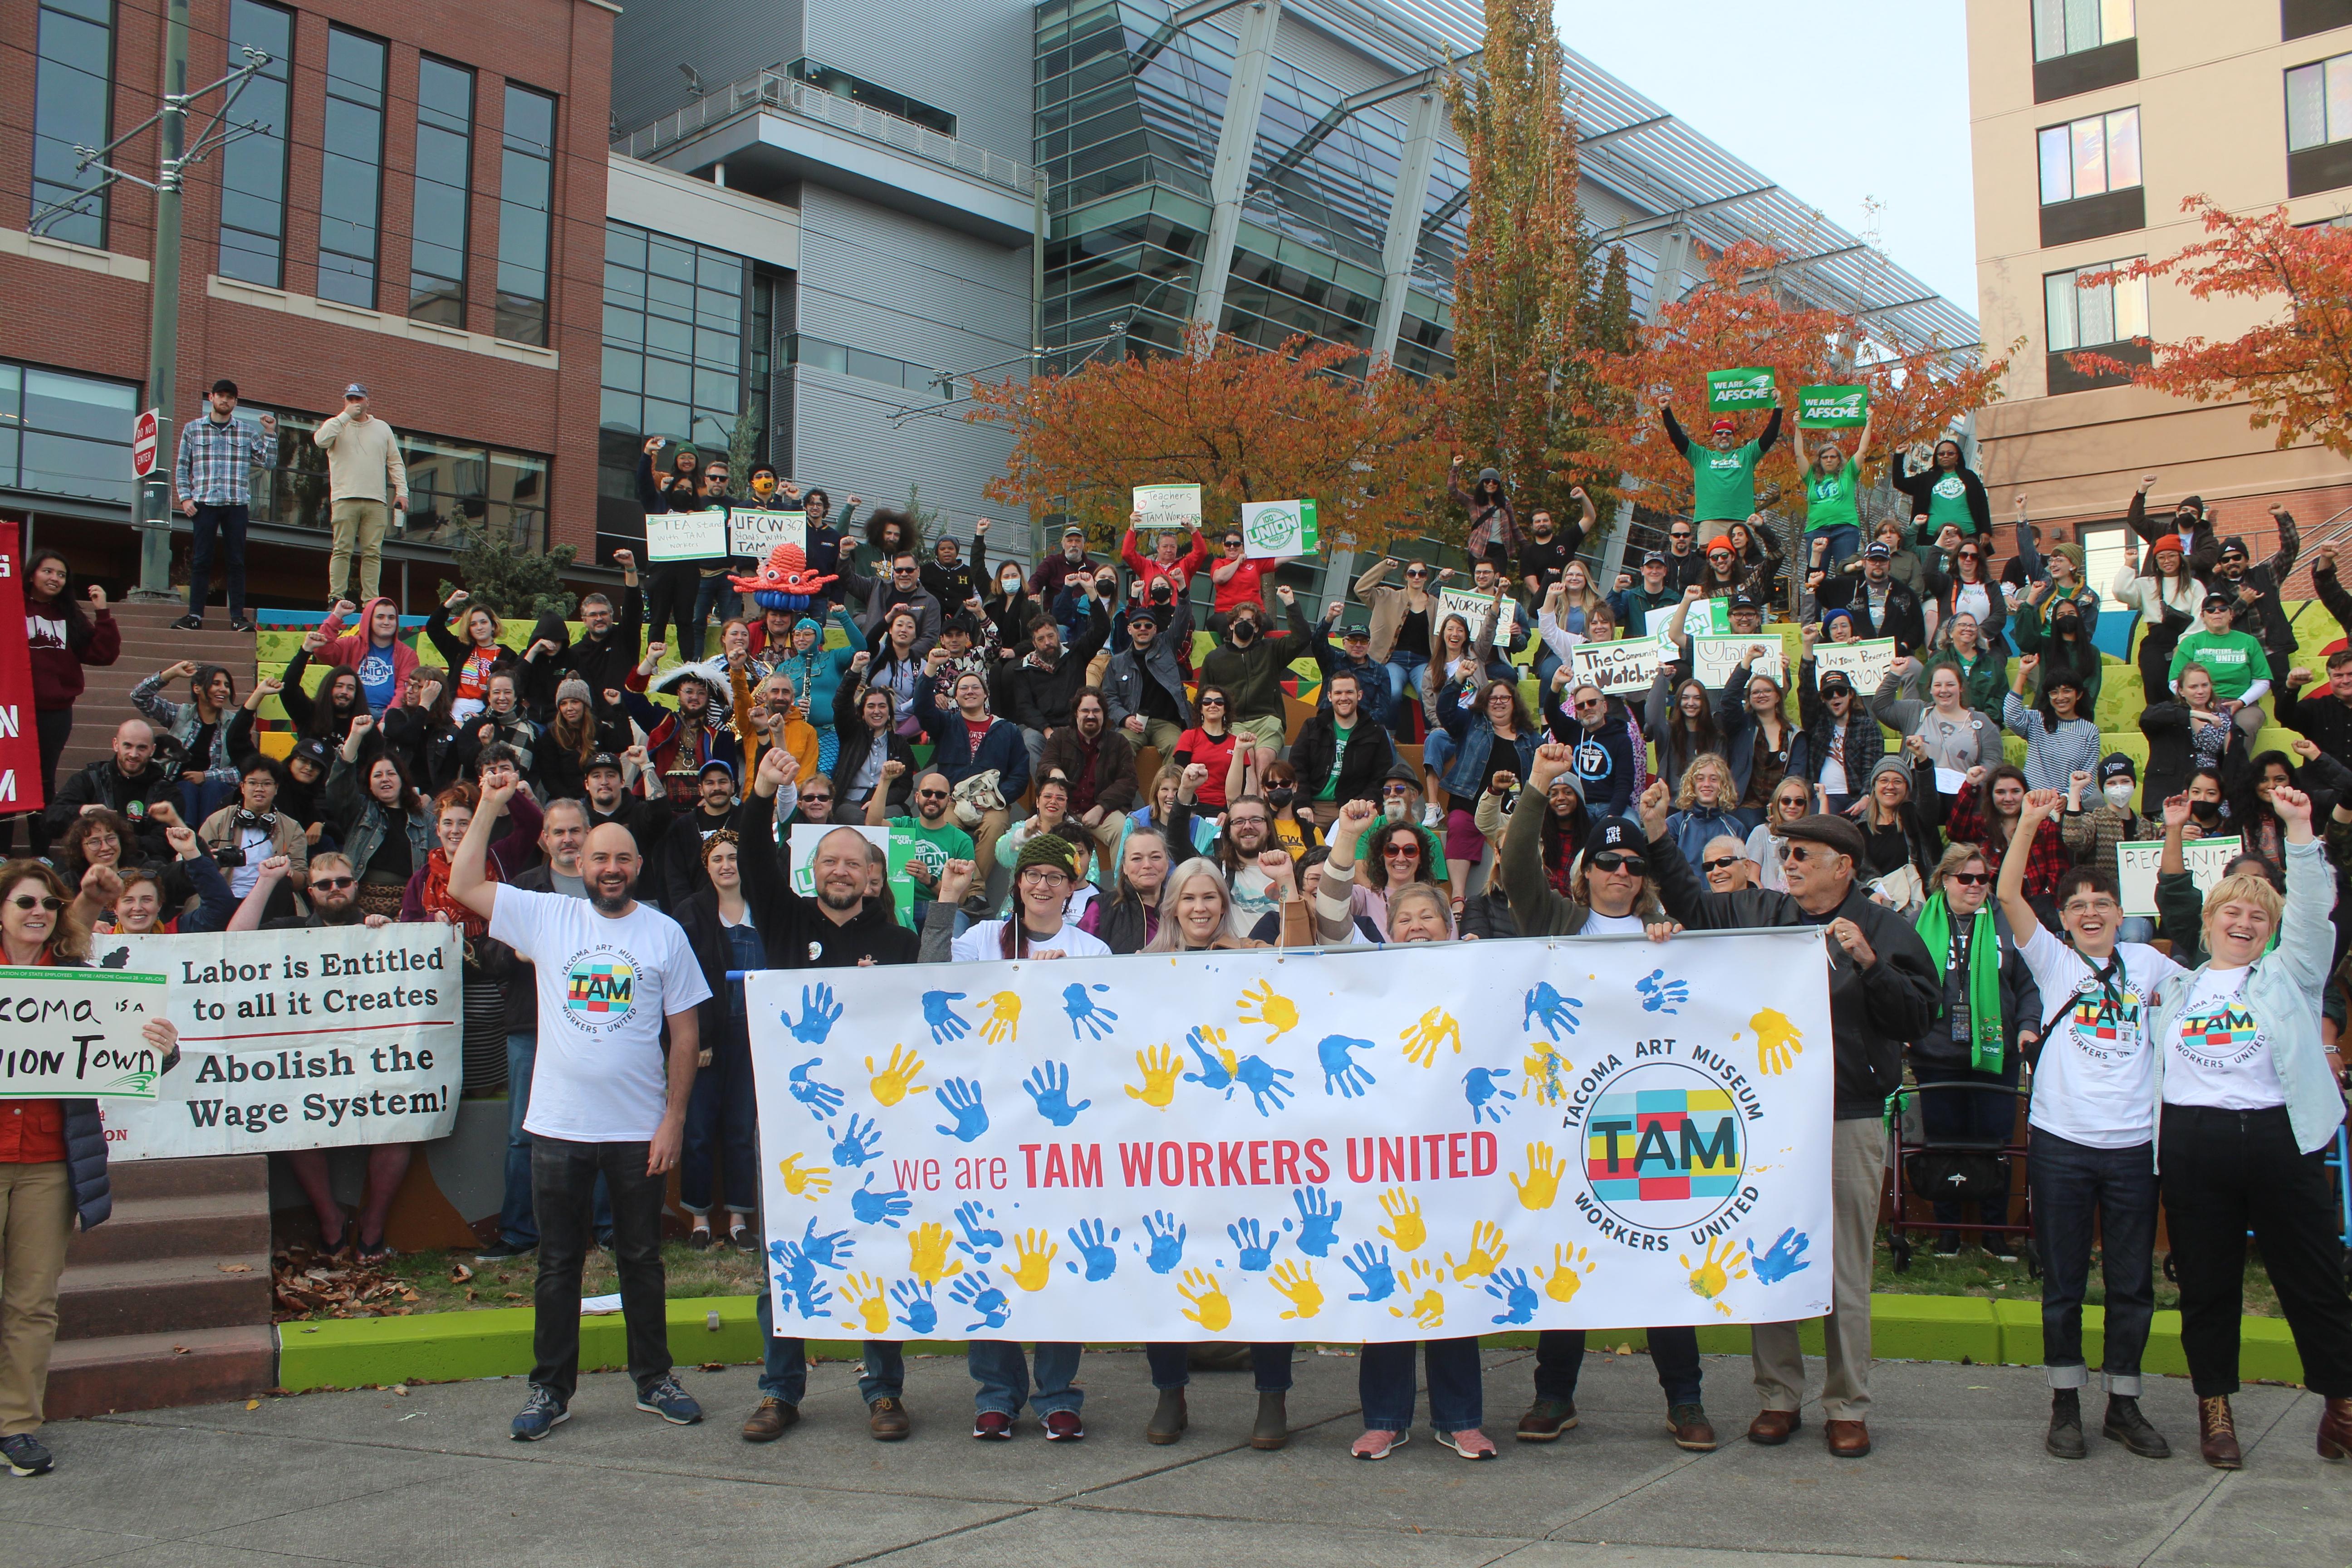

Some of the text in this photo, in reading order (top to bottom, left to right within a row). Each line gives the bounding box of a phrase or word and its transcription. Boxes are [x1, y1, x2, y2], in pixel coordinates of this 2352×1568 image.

[1715, 388, 1768, 402] AFSCME
[1805, 407, 1859, 418] AFSCME
[137, 423, 155, 439] DO NOT
[137, 451, 151, 466] ENTER
[1144, 490, 1192, 501] Teachers
[665, 520, 725, 531] TEA stands
[735, 514, 804, 533] UFCW 367
[1141, 511, 1163, 523] TAM
[735, 531, 760, 541] Stands
[1247, 514, 1298, 544] UNION
[1269, 534, 1284, 544] PROUD
[737, 541, 766, 552] TAM
[958, 575, 968, 584] H
[1445, 594, 1510, 622] WORKES
[1575, 650, 1613, 670] The
[1698, 642, 1774, 662] Unin
[2216, 654, 2246, 662] UNITED
[1849, 664, 1891, 686] RYONE
[1582, 755, 1603, 772] 17
[2125, 848, 2238, 869] RECGNIZE
[182, 947, 444, 984] Labor is Entitled
[562, 949, 589, 975] TACOMA
[618, 949, 643, 981] MUSEUM
[572, 975, 631, 1000] TAM
[133, 1003, 144, 1012] A
[193, 985, 438, 1021] to all it Creates
[562, 1004, 637, 1034] WORKERS UNITED
[2187, 1011, 2253, 1033] TAM
[1982, 1045, 2000, 1054] SCME
[2069, 1027, 2107, 1059] WORKERS
[2175, 1034, 2265, 1068] WORKERS UNITED
[196, 1044, 433, 1083] Abolish the
[1563, 1039, 1764, 1129] TACOMA ART MUSEUM
[186, 1085, 447, 1133] Wage System!
[1592, 1117, 1735, 1173] TAM
[892, 1131, 1497, 1191] we are TAM WORKERS UNITED
[1574, 1186, 1759, 1251] WORKERS UNITED
